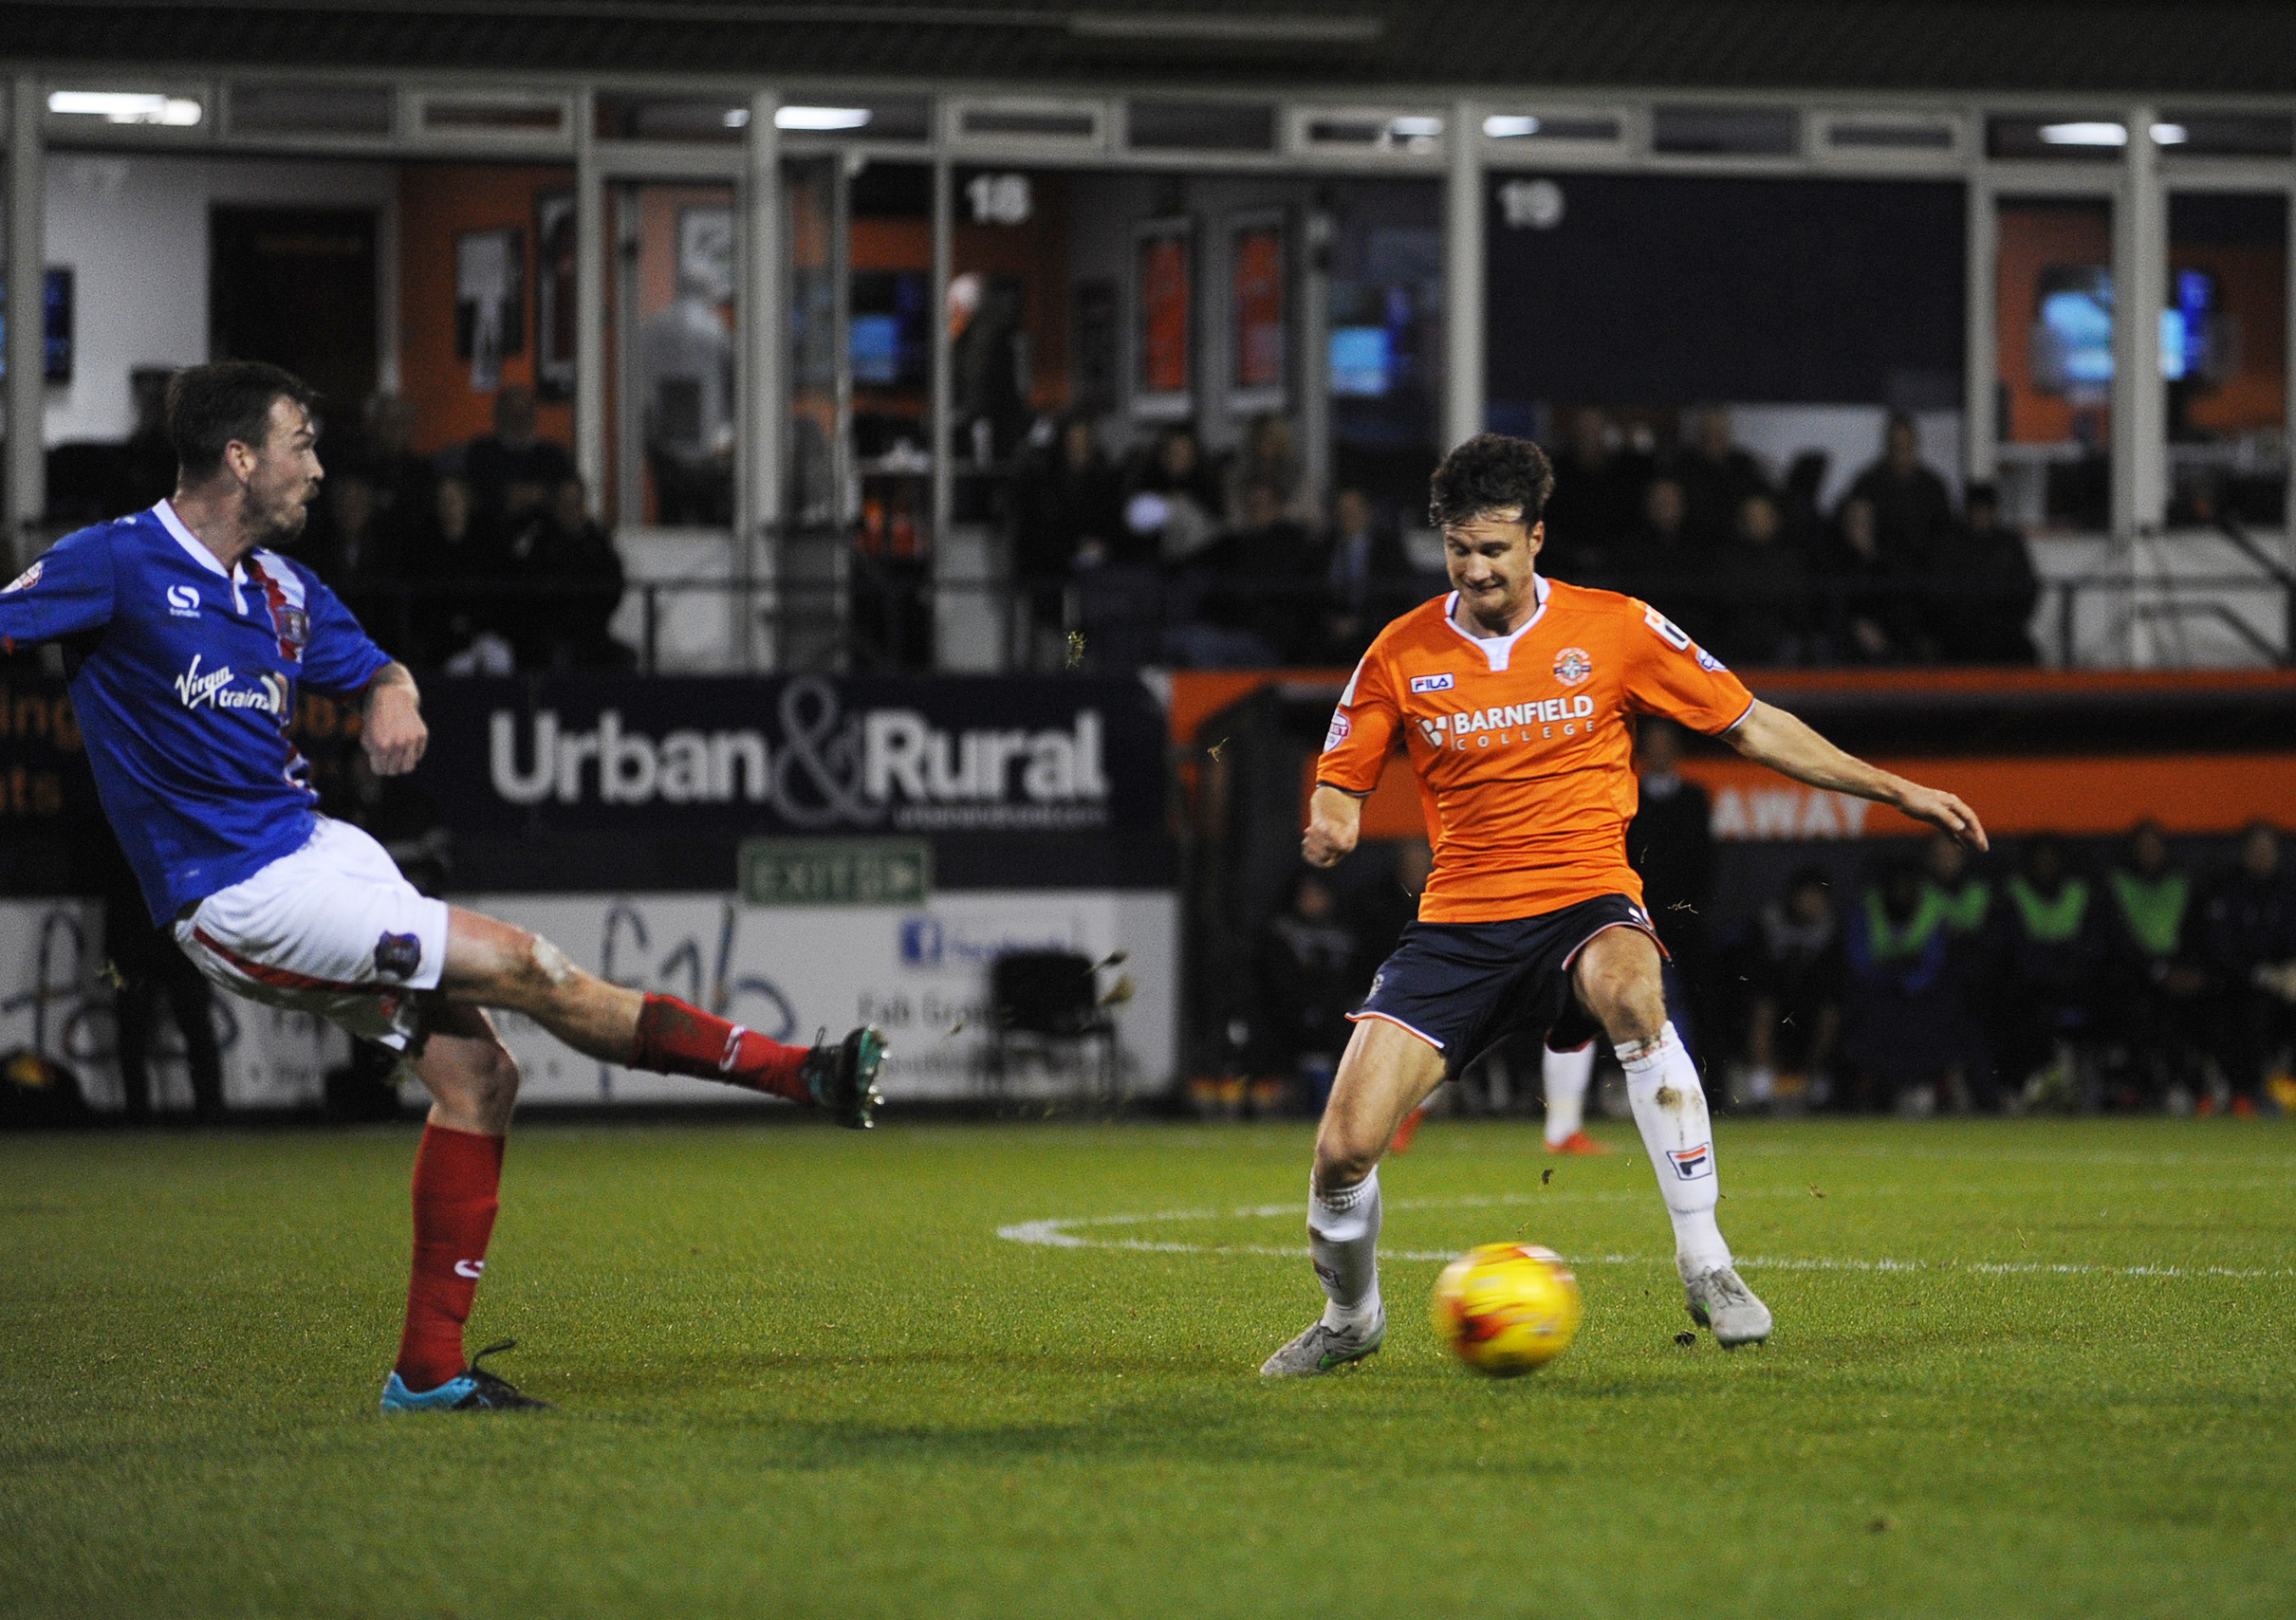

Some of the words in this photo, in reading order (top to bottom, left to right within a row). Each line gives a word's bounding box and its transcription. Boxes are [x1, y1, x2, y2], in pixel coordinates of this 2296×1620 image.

[176, 654, 234, 709] Virgin
[1415, 676, 1450, 691] FILA
[1454, 695, 1594, 735] BARNFIELD
[1456, 721, 1594, 751] COLLEGE
[489, 710, 769, 803] Urban
[862, 710, 1109, 801] Rural
[1710, 786, 1873, 841] AWAY
